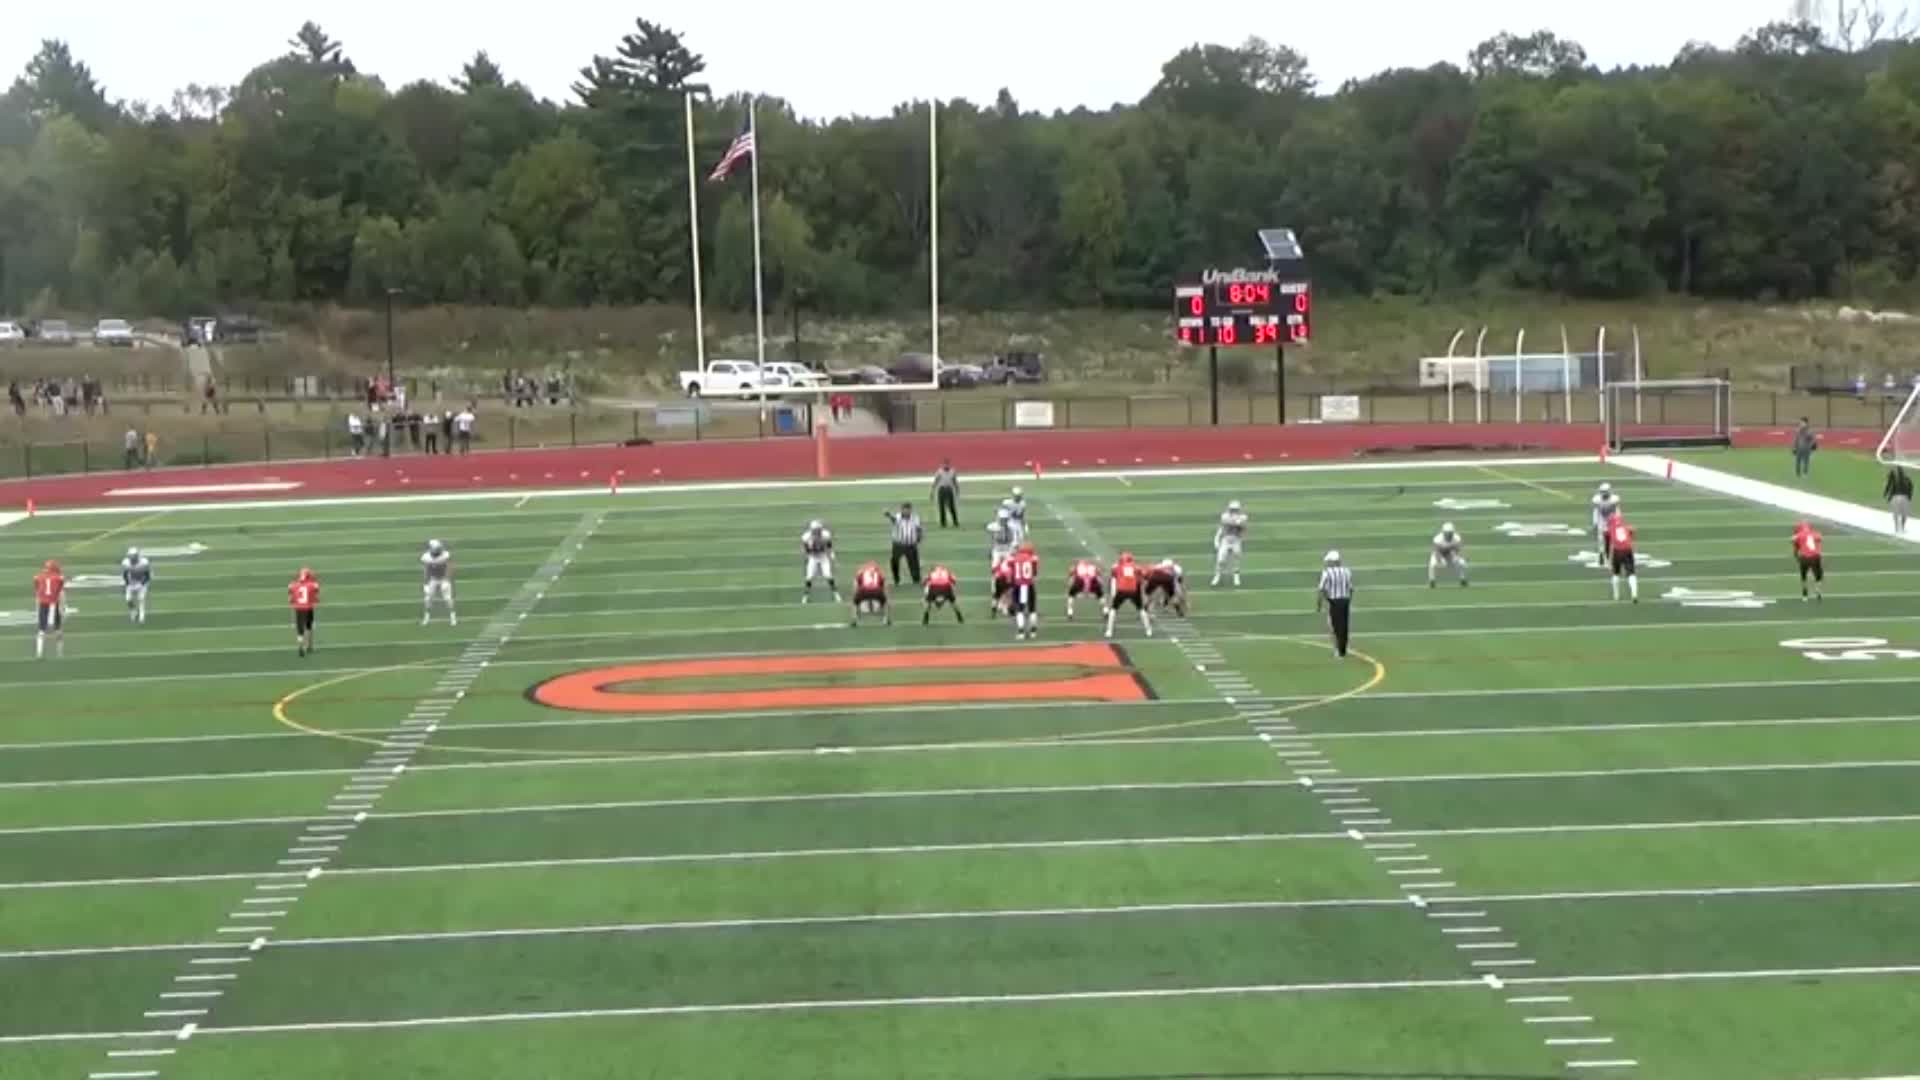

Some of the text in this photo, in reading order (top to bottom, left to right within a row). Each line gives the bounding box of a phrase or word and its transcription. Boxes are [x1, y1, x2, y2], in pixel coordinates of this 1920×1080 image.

[1203, 267, 1279, 284] UniBank
[1015, 561, 1032, 579] 10
[44, 578, 52, 595] 1
[298, 587, 308, 603] 3
